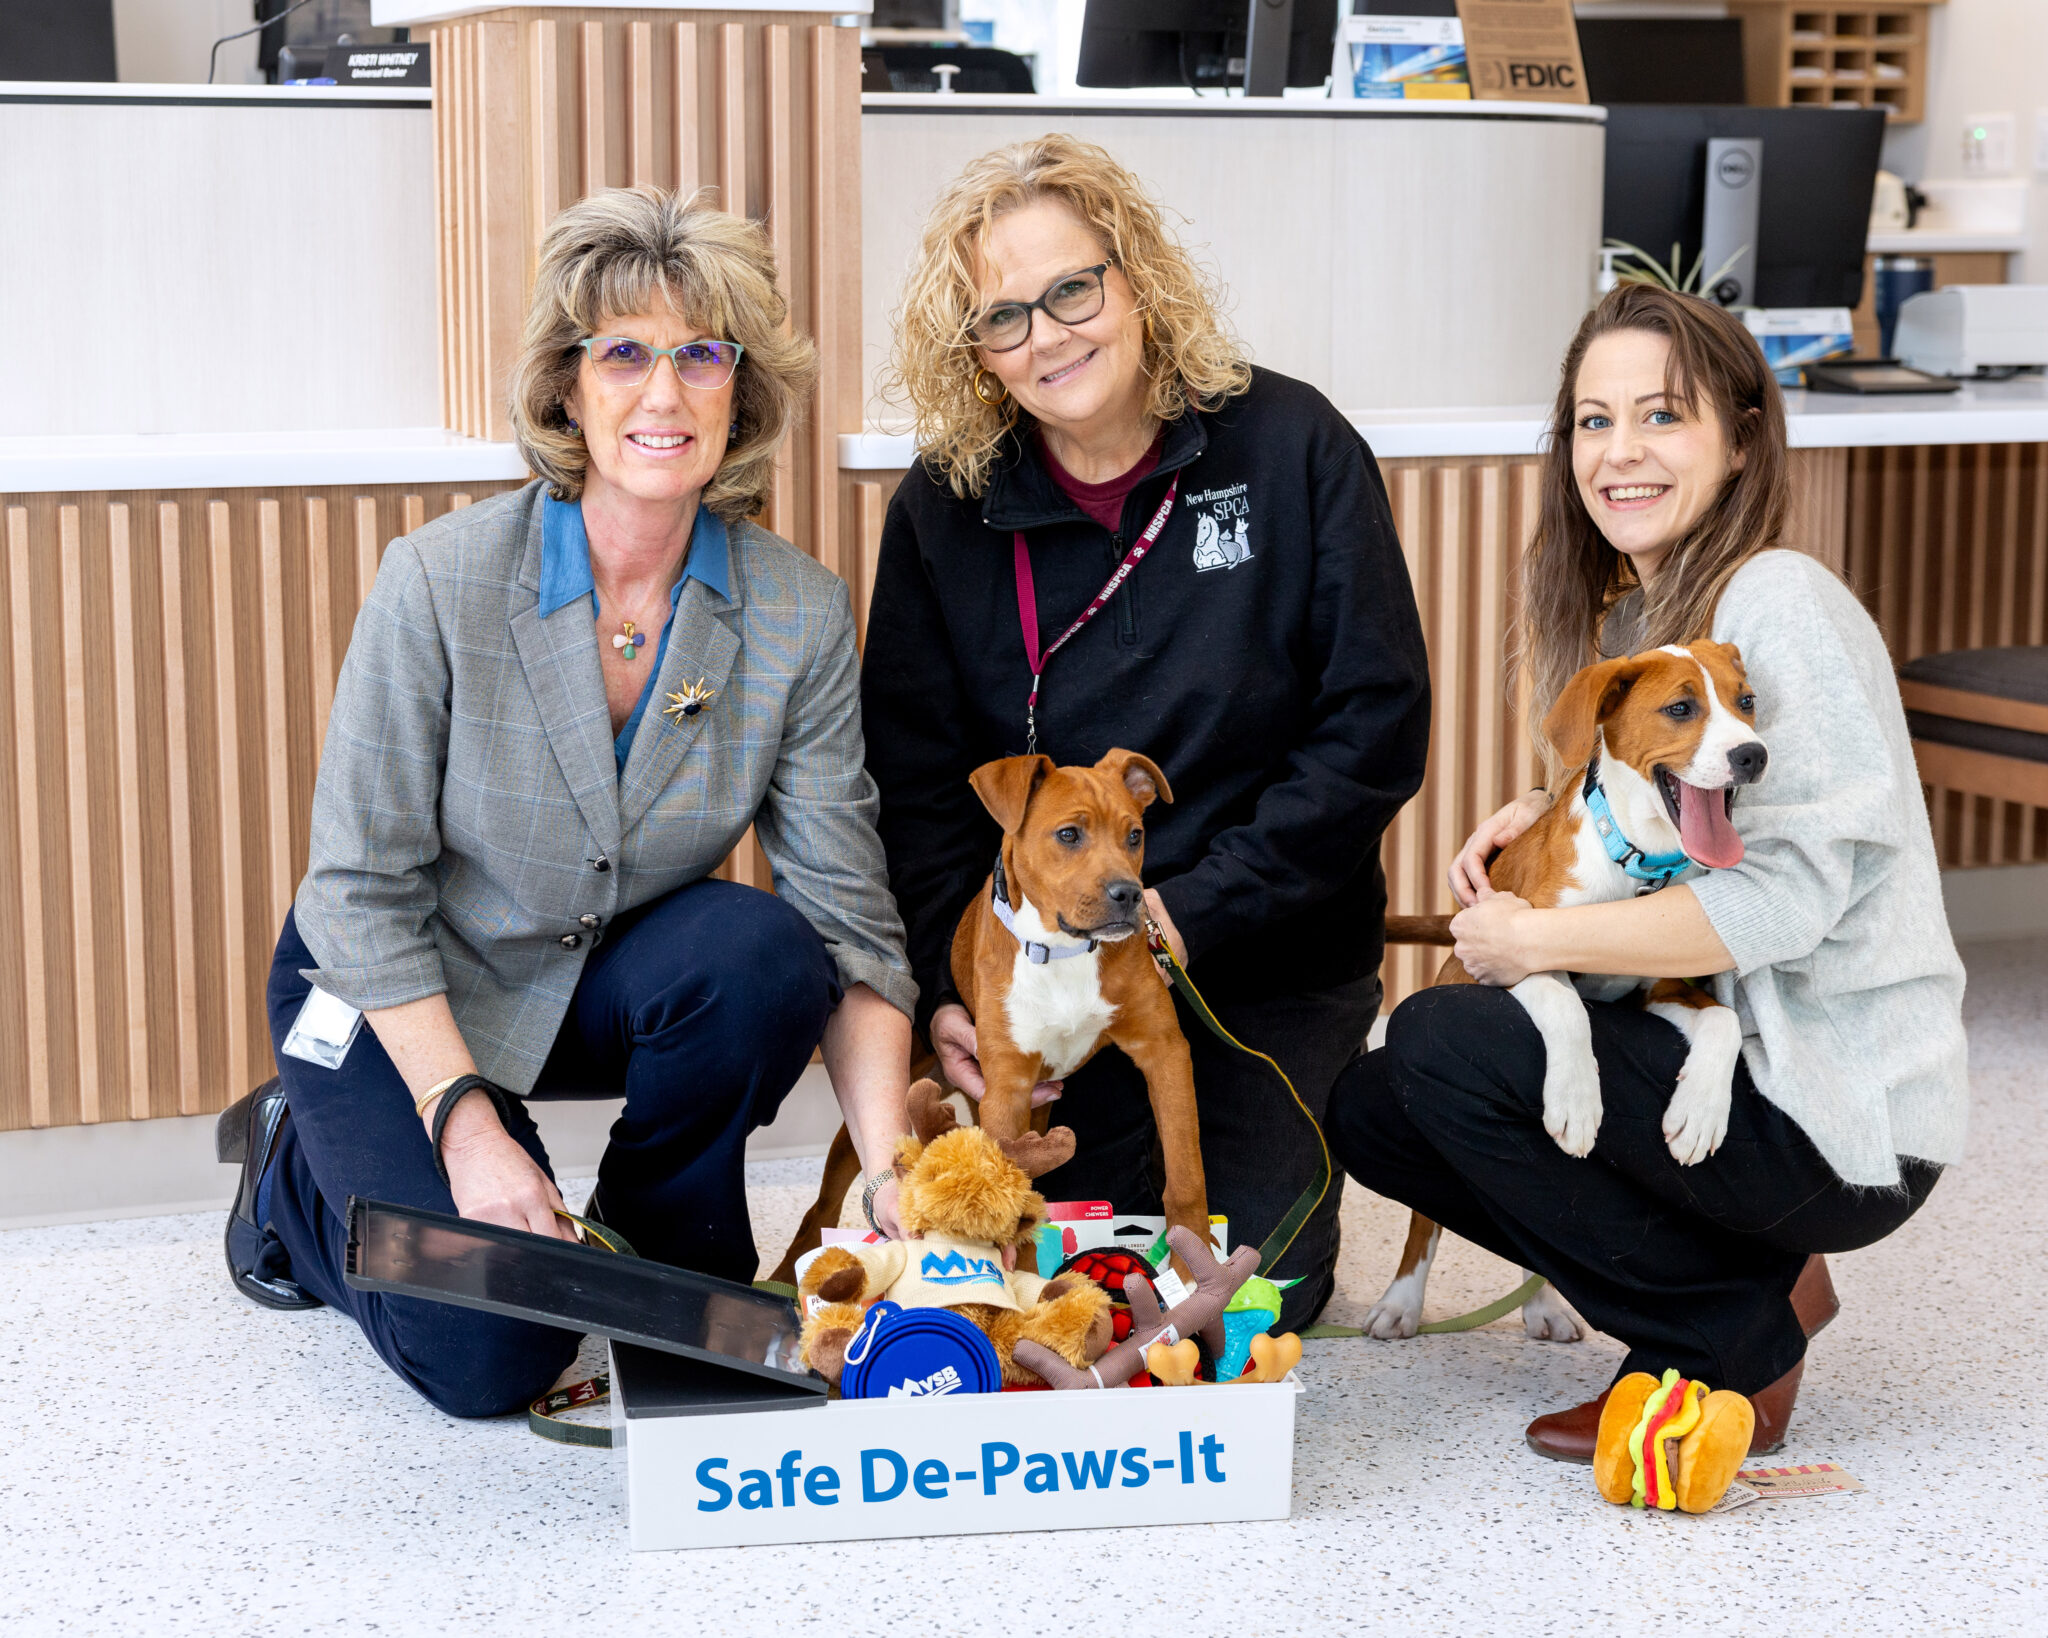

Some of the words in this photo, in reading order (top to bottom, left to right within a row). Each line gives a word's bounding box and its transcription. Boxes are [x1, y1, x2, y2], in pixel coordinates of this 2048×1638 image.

[348, 53, 378, 67] KRISTI
[378, 52, 419, 66] WHITNEY
[1509, 63, 1576, 88] FDIC
[1185, 493, 1204, 507] New
[1203, 482, 1248, 501] Hampshire
[1143, 499, 1173, 542] NHSPCA
[1213, 495, 1250, 521] SPCA
[1099, 563, 1133, 601] NHSPCA
[696, 1450, 840, 1512] Safe
[861, 1431, 1226, 1502] De-Paws-It
